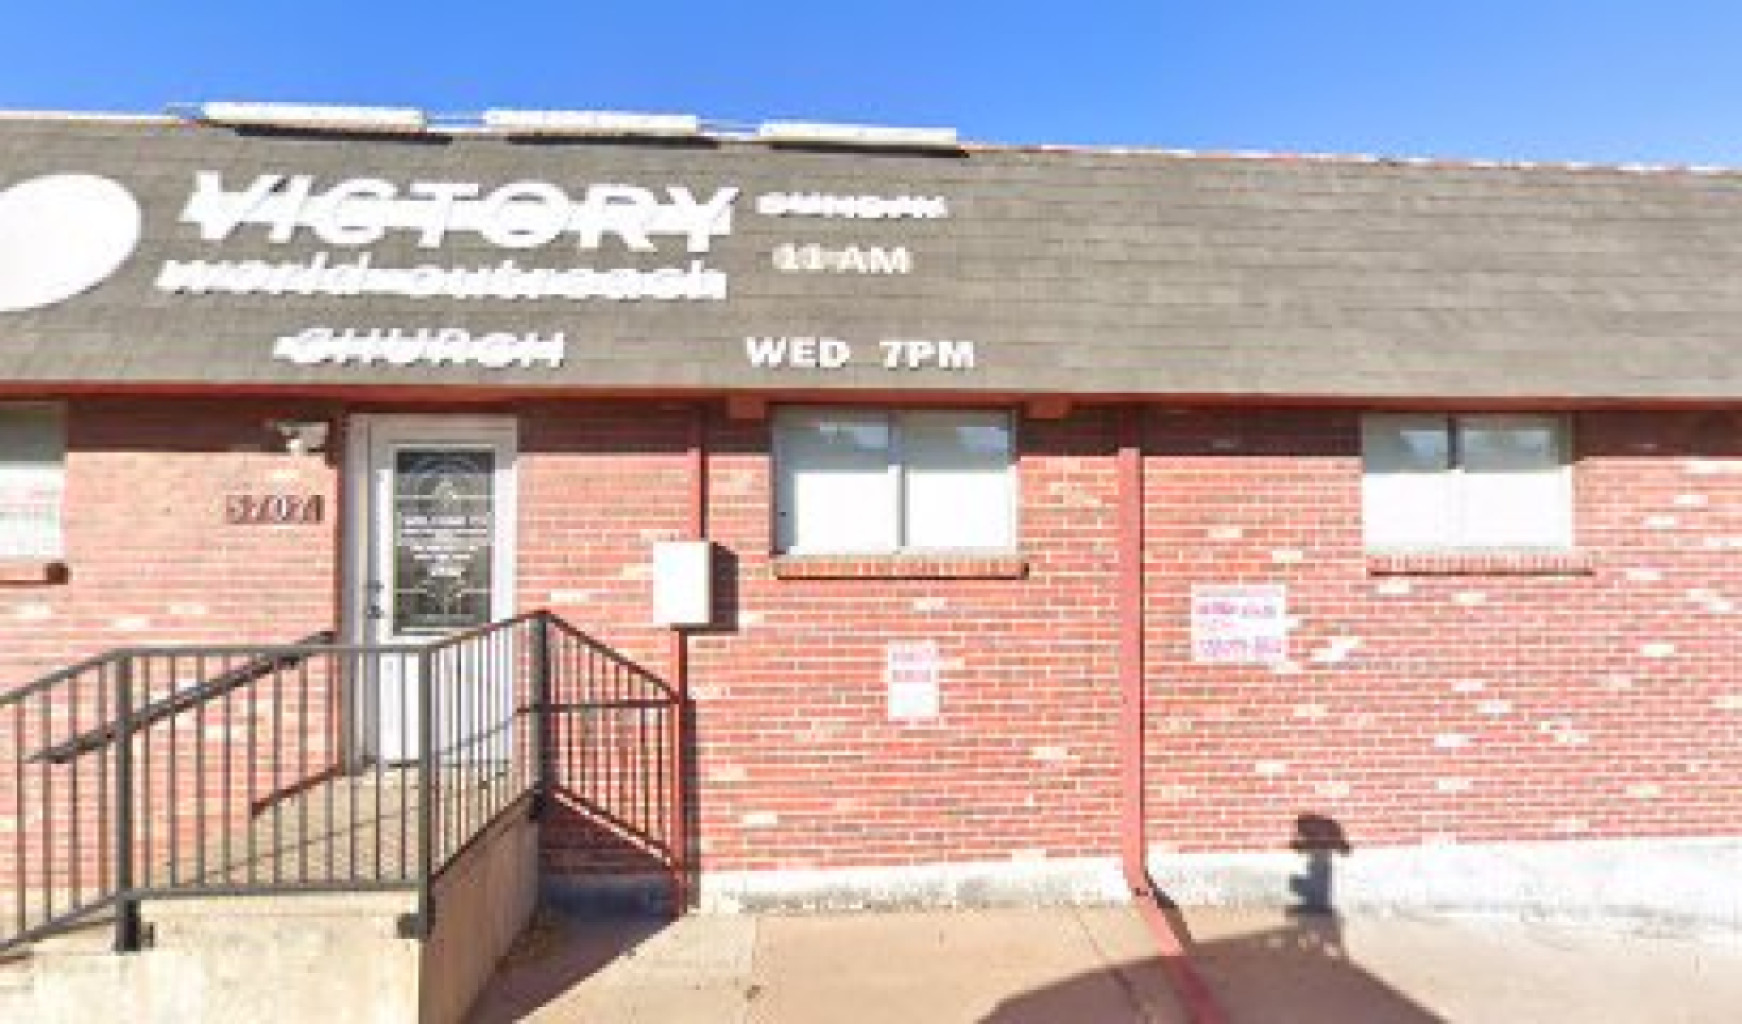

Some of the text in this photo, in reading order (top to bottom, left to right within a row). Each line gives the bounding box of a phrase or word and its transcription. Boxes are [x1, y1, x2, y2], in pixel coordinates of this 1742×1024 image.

[180, 170, 740, 252] VICTORY
[274, 326, 566, 368] CHURCH
[746, 336, 975, 368] WED 7PM
